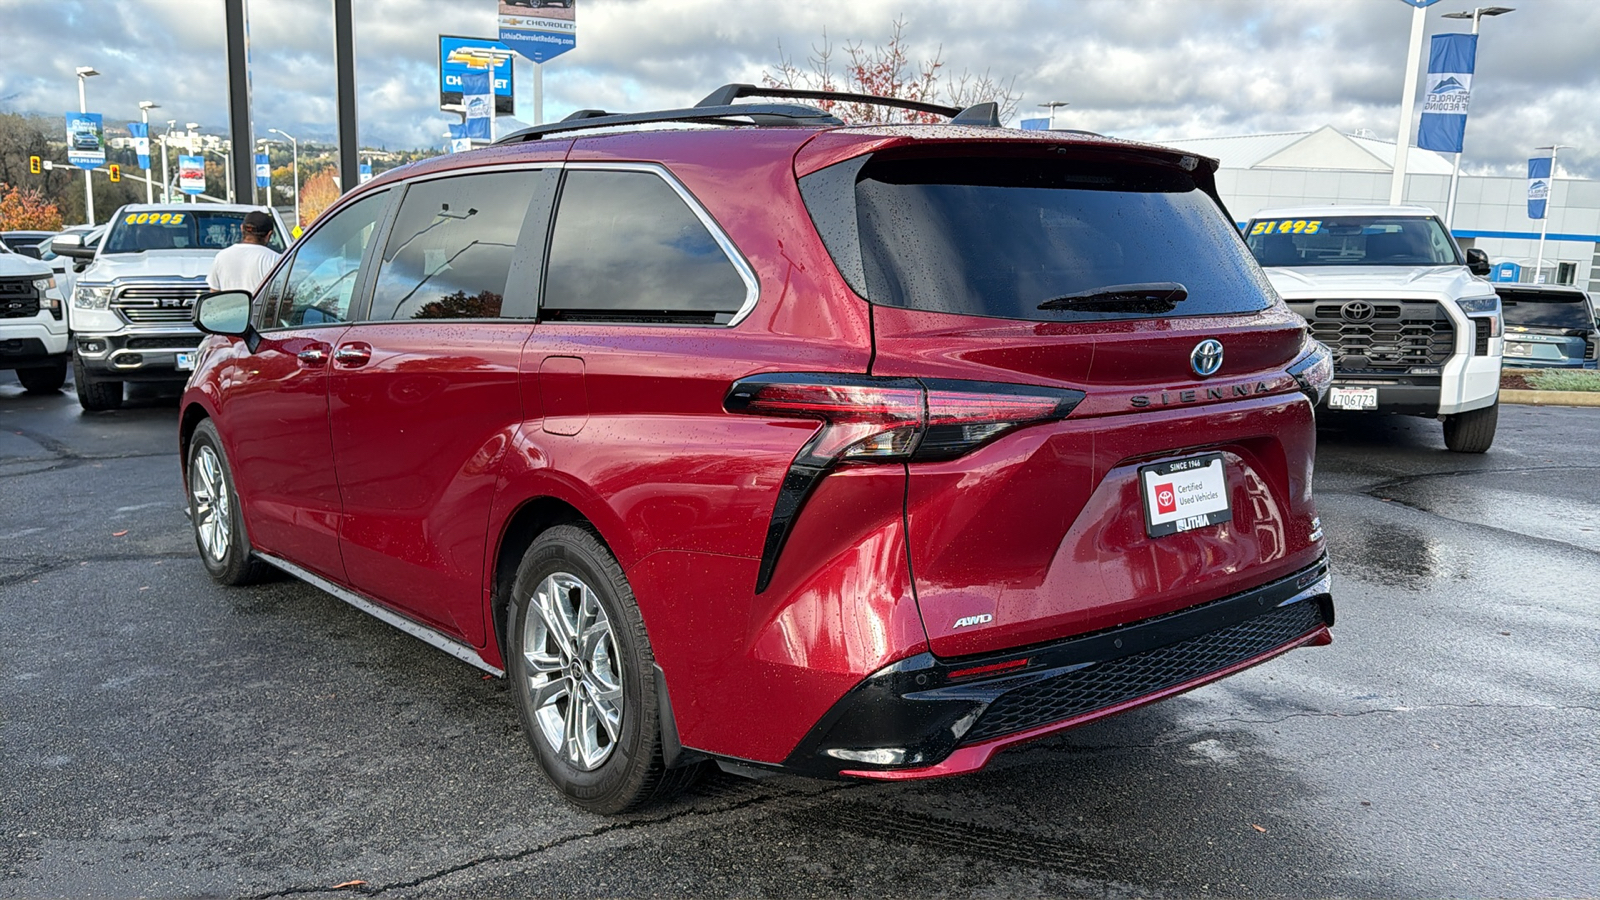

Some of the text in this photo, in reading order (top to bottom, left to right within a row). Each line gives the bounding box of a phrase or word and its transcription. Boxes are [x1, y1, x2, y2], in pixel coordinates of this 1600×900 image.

[526, 20, 573, 29] CHEVROLET
[501, 32, 574, 45] LithiaChevroletRedding.com
[125, 213, 185, 225] 40995
[1131, 382, 1269, 407] SIENNA
[1169, 460, 1201, 471] SINCE 1946
[1177, 481, 1203, 493] Certified
[1179, 491, 1219, 506] Used Vehicles
[1184, 514, 1210, 529] LITHIA
[952, 613, 993, 629] AWD
